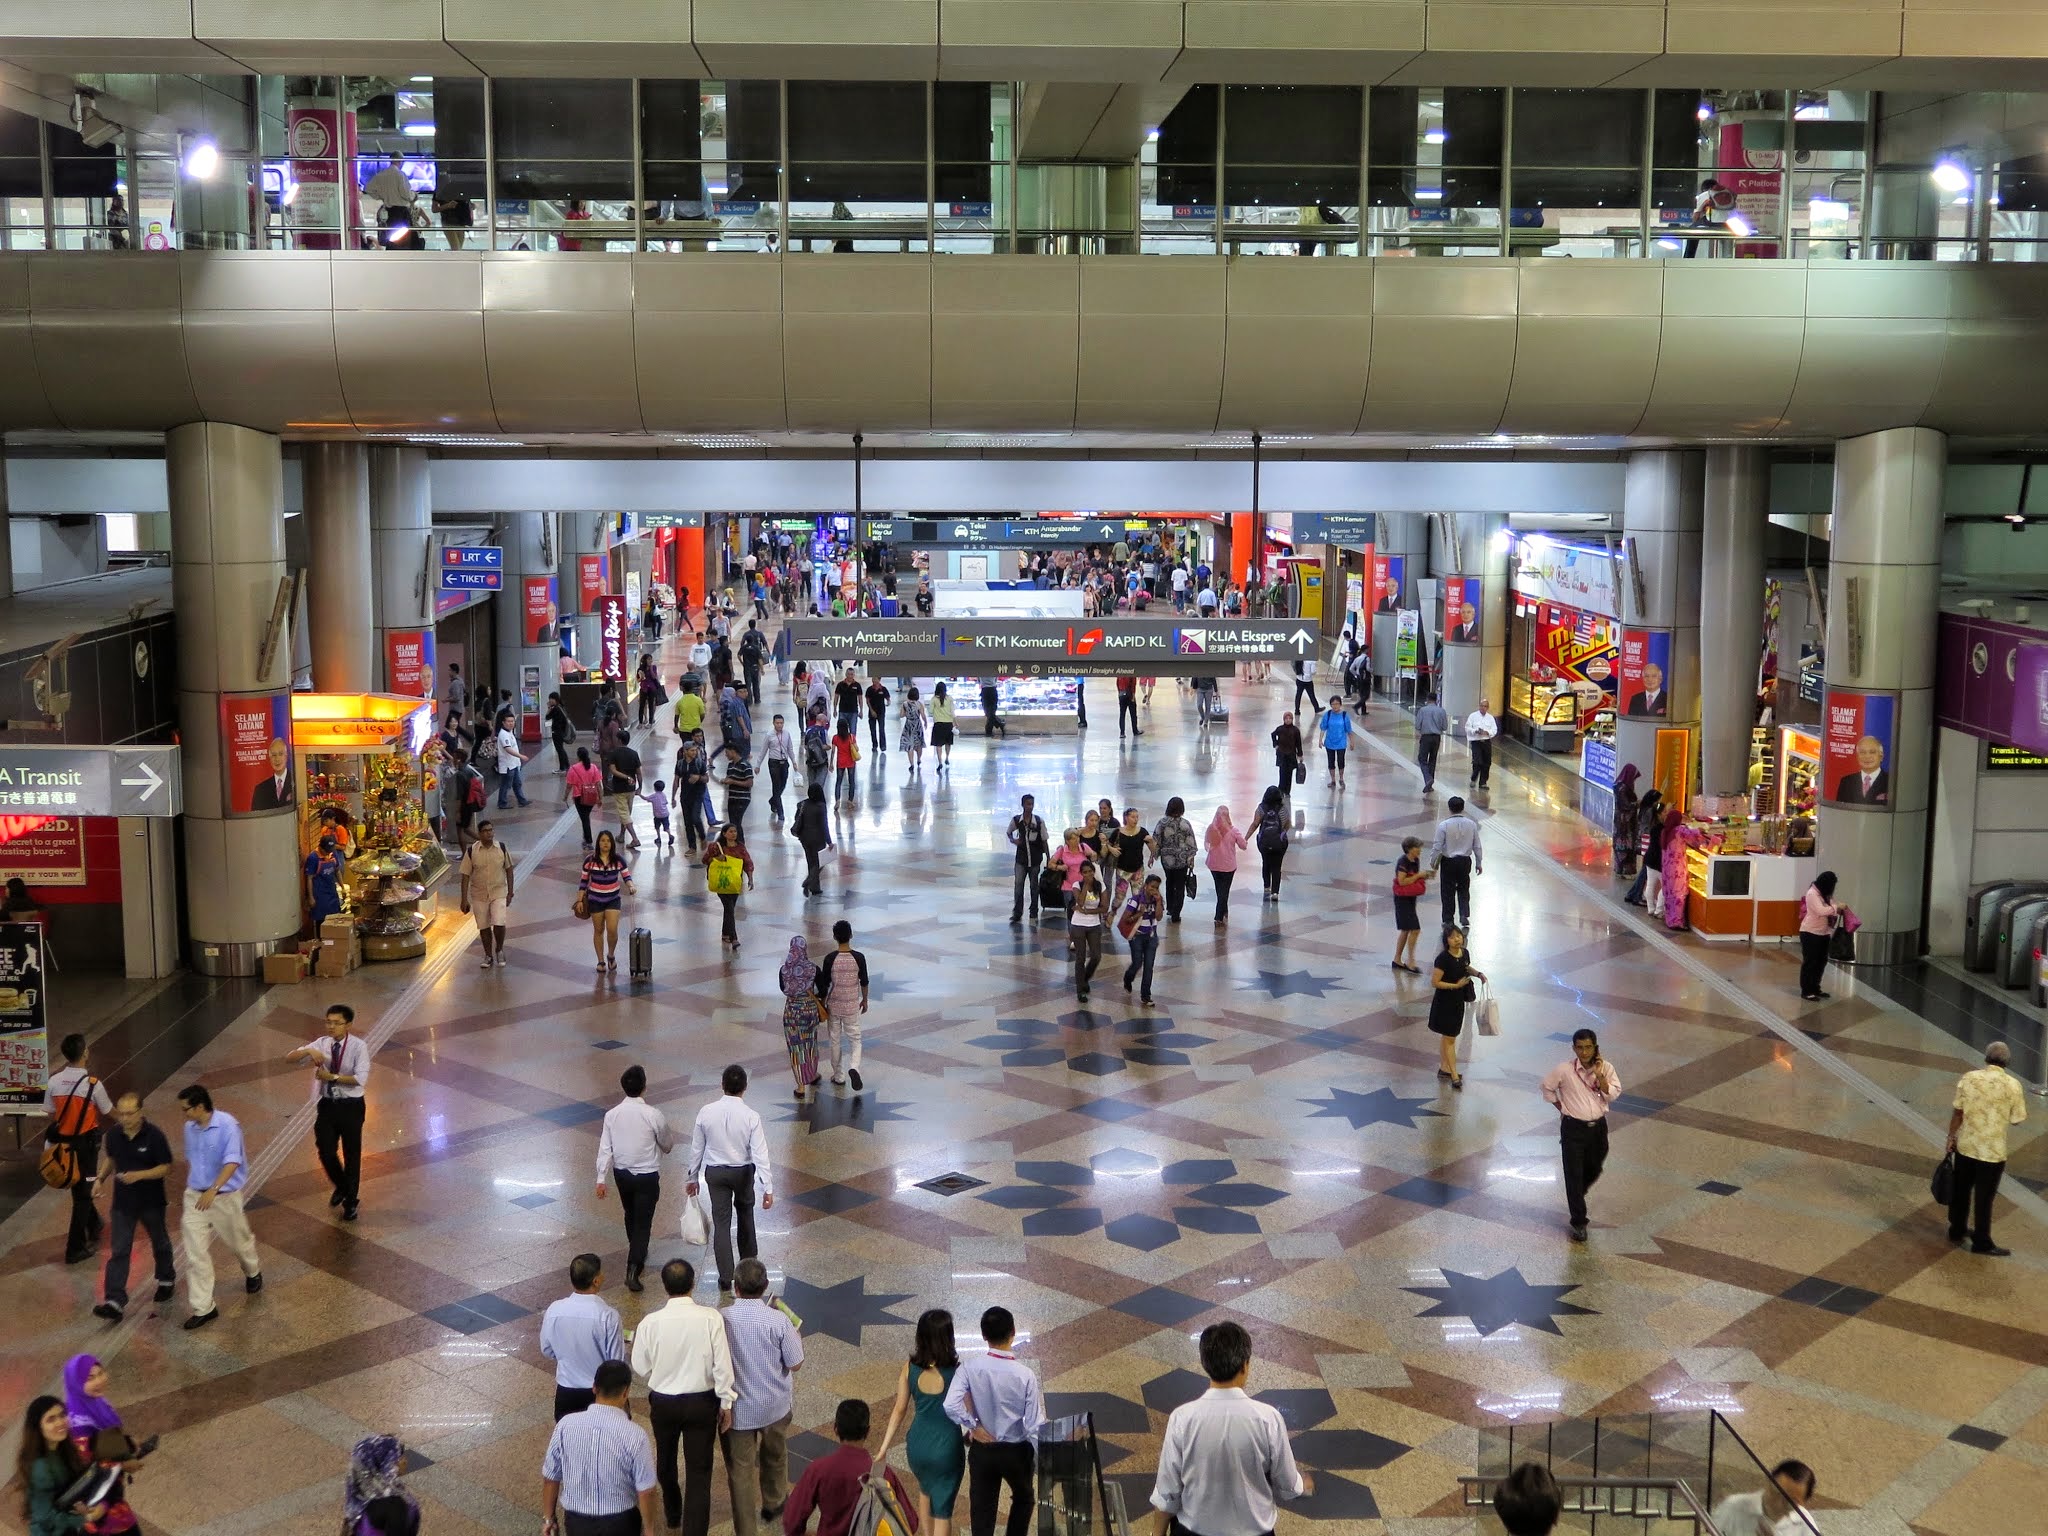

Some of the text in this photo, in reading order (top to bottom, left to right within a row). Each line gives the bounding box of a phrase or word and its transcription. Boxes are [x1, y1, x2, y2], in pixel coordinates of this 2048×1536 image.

[732, 204, 755, 212] Sentral
[462, 553, 481, 562] LRT
[460, 575, 486, 583] TIKET
[604, 600, 623, 678] Secret Recipe
[822, 631, 938, 648] KTM Antarabandar
[975, 635, 1065, 648] KTM Komuter
[1105, 635, 1166, 648] RAPID KL
[1208, 630, 1286, 644] KLIA Ekspres
[1624, 640, 1643, 649] SELAMAT
[397, 650, 418, 658] DATANG
[854, 645, 894, 657] Intercity
[1047, 666, 1056, 674] Di
[1831, 706, 1857, 717] SELAMAT
[234, 712, 266, 723] SELAMAT
[1832, 714, 1854, 724] DATANG
[237, 721, 264, 731] DATANG
[235, 749, 251, 757] KUALA
[15, 767, 82, 786] Transit
[7, 838, 33, 846] secret
[34, 838, 44, 846] to
[52, 838, 76, 848] great
[33, 848, 66, 857] burger.
